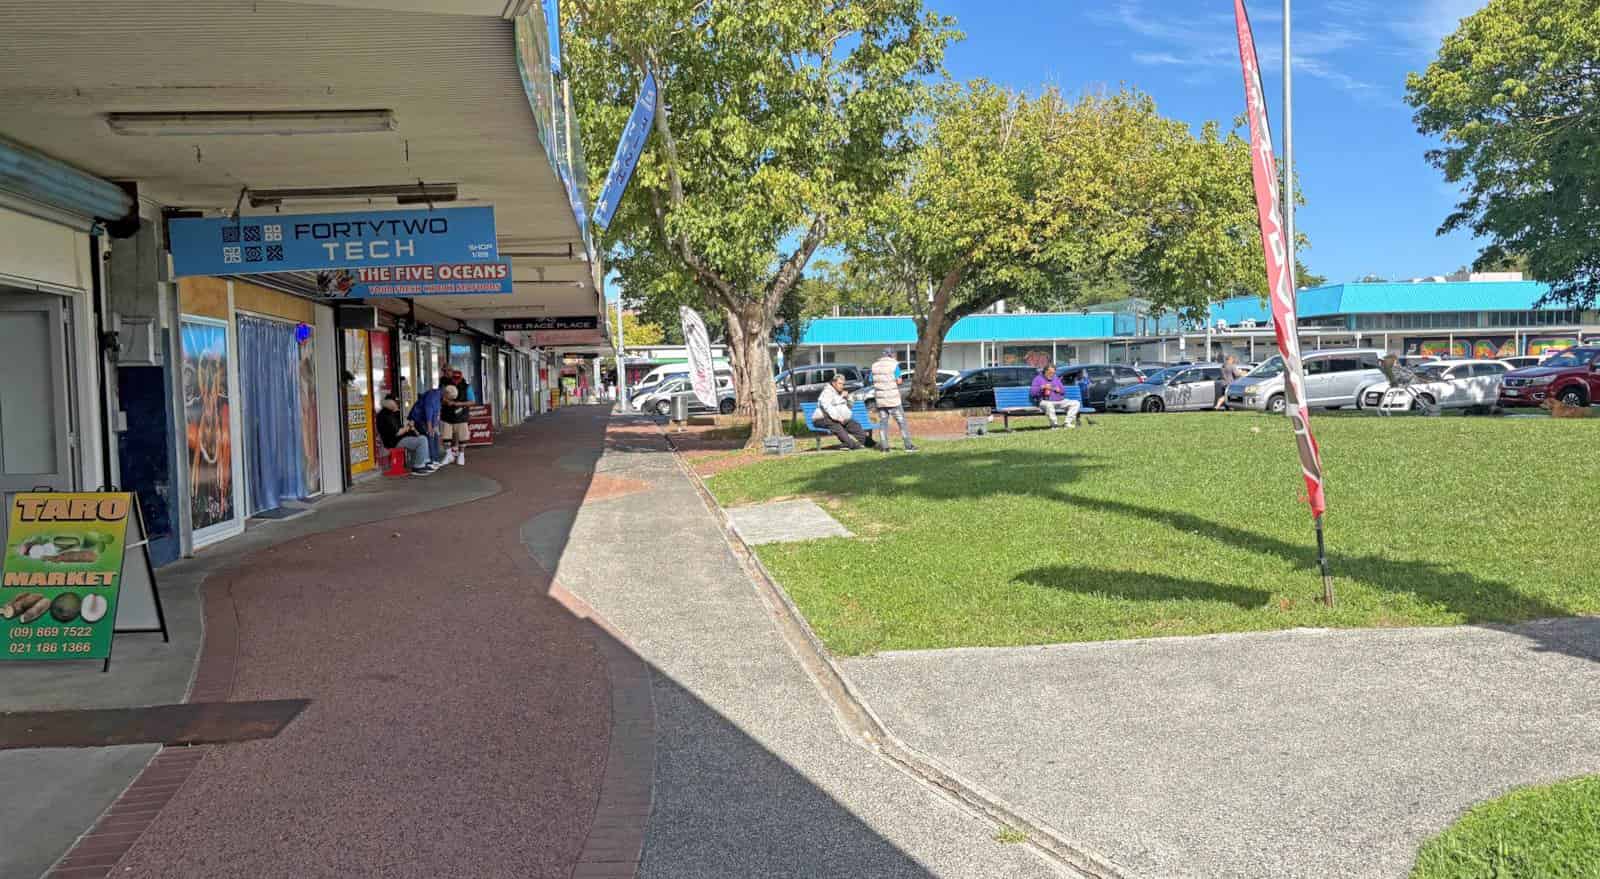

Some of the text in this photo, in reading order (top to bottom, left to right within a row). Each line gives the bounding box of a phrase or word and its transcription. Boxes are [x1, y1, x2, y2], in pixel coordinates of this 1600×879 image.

[294, 217, 449, 240] FORTYTWO
[321, 239, 415, 261] TECH
[357, 263, 508, 282] THE FIVE OCEANS
[526, 322, 555, 330] RACE
[556, 321, 592, 329] PLACE
[16, 498, 127, 522] TARO
[3, 571, 118, 588] MARKET
[9, 626, 33, 639] (09)
[63, 626, 92, 638] 7522
[9, 642, 32, 654] 021
